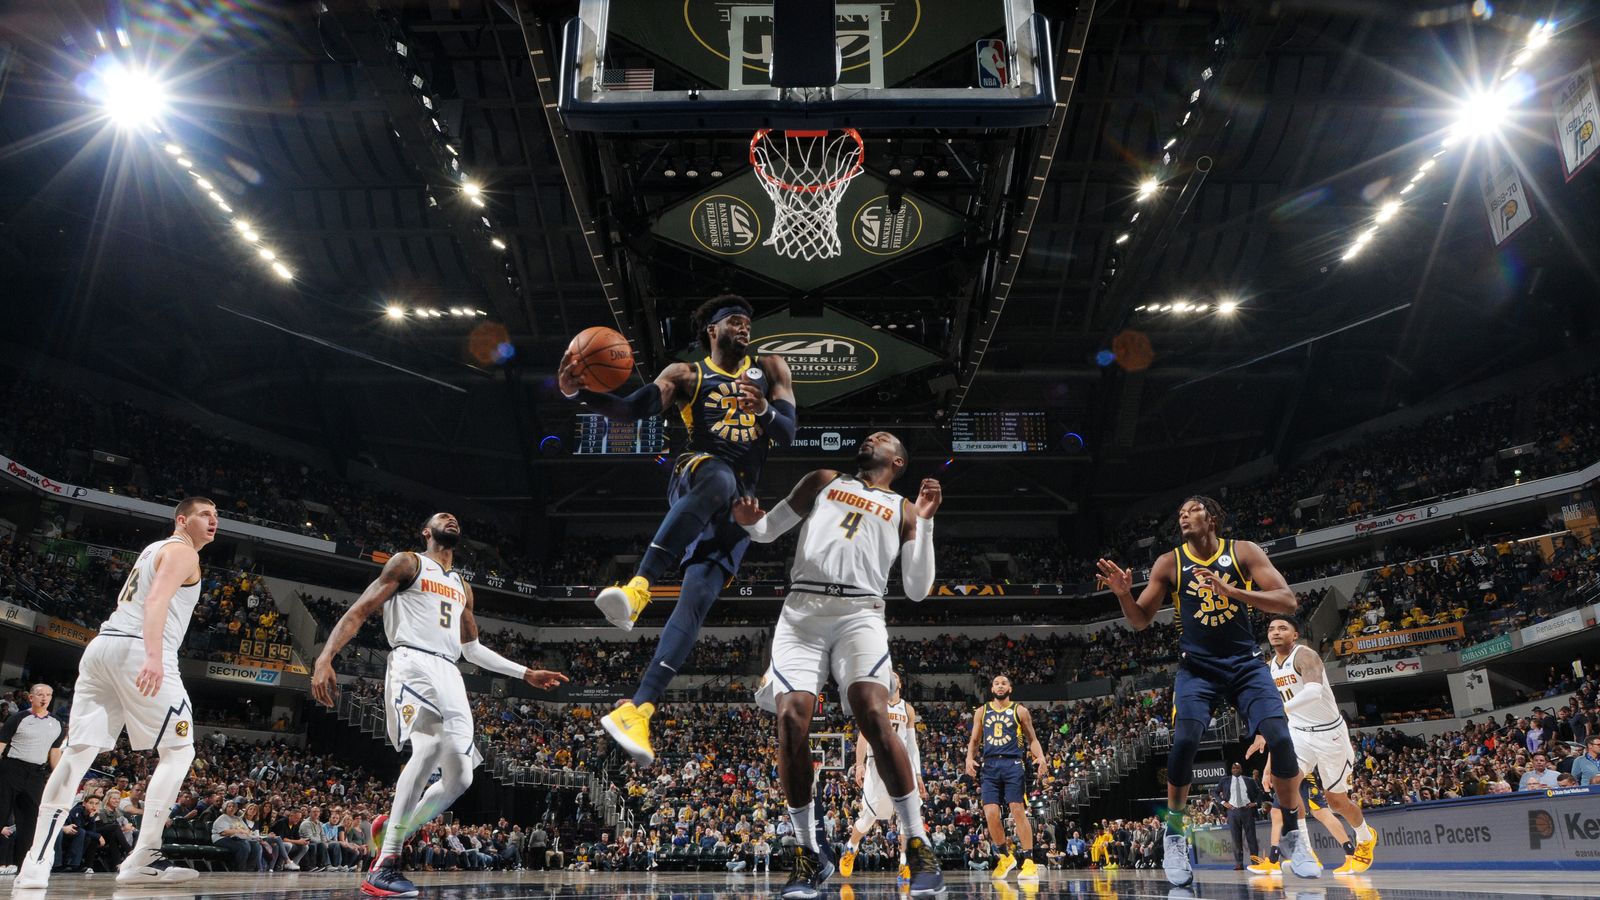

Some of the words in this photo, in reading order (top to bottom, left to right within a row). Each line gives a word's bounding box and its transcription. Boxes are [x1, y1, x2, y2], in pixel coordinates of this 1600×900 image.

[983, 77, 997, 87] NBA
[706, 202, 720, 247] FIELDHOUSE
[892, 204, 907, 248] FIELDHOUSE
[790, 364, 857, 372] DHOUSE
[809, 439, 820, 447] ON
[841, 439, 856, 447] APP
[826, 488, 894, 522] NUGGETS
[839, 511, 864, 540] 4
[487, 580, 503, 588] 4/12
[517, 586, 532, 594] 9/11
[739, 587, 753, 596] 65
[421, 578, 466, 606] NUGGETS
[6, 607, 19, 620] ipl
[440, 600, 452, 628] 5
[1535, 615, 1576, 634] Renaissance
[1357, 640, 1378, 650] HIGH
[1378, 633, 1411, 647] OCTANE
[1411, 626, 1457, 642] DRUMLINE
[1461, 646, 1489, 662] EMBASSY
[1488, 640, 1512, 654] SUITES
[208, 665, 258, 679] SECTION
[1343, 665, 1394, 679] KeyBank
[891, 723, 899, 732] 7
[993, 722, 1003, 738] 6
[1192, 767, 1226, 778] TBOUND
[1382, 826, 1432, 846] Indiana
[1435, 823, 1492, 845] Pacers
